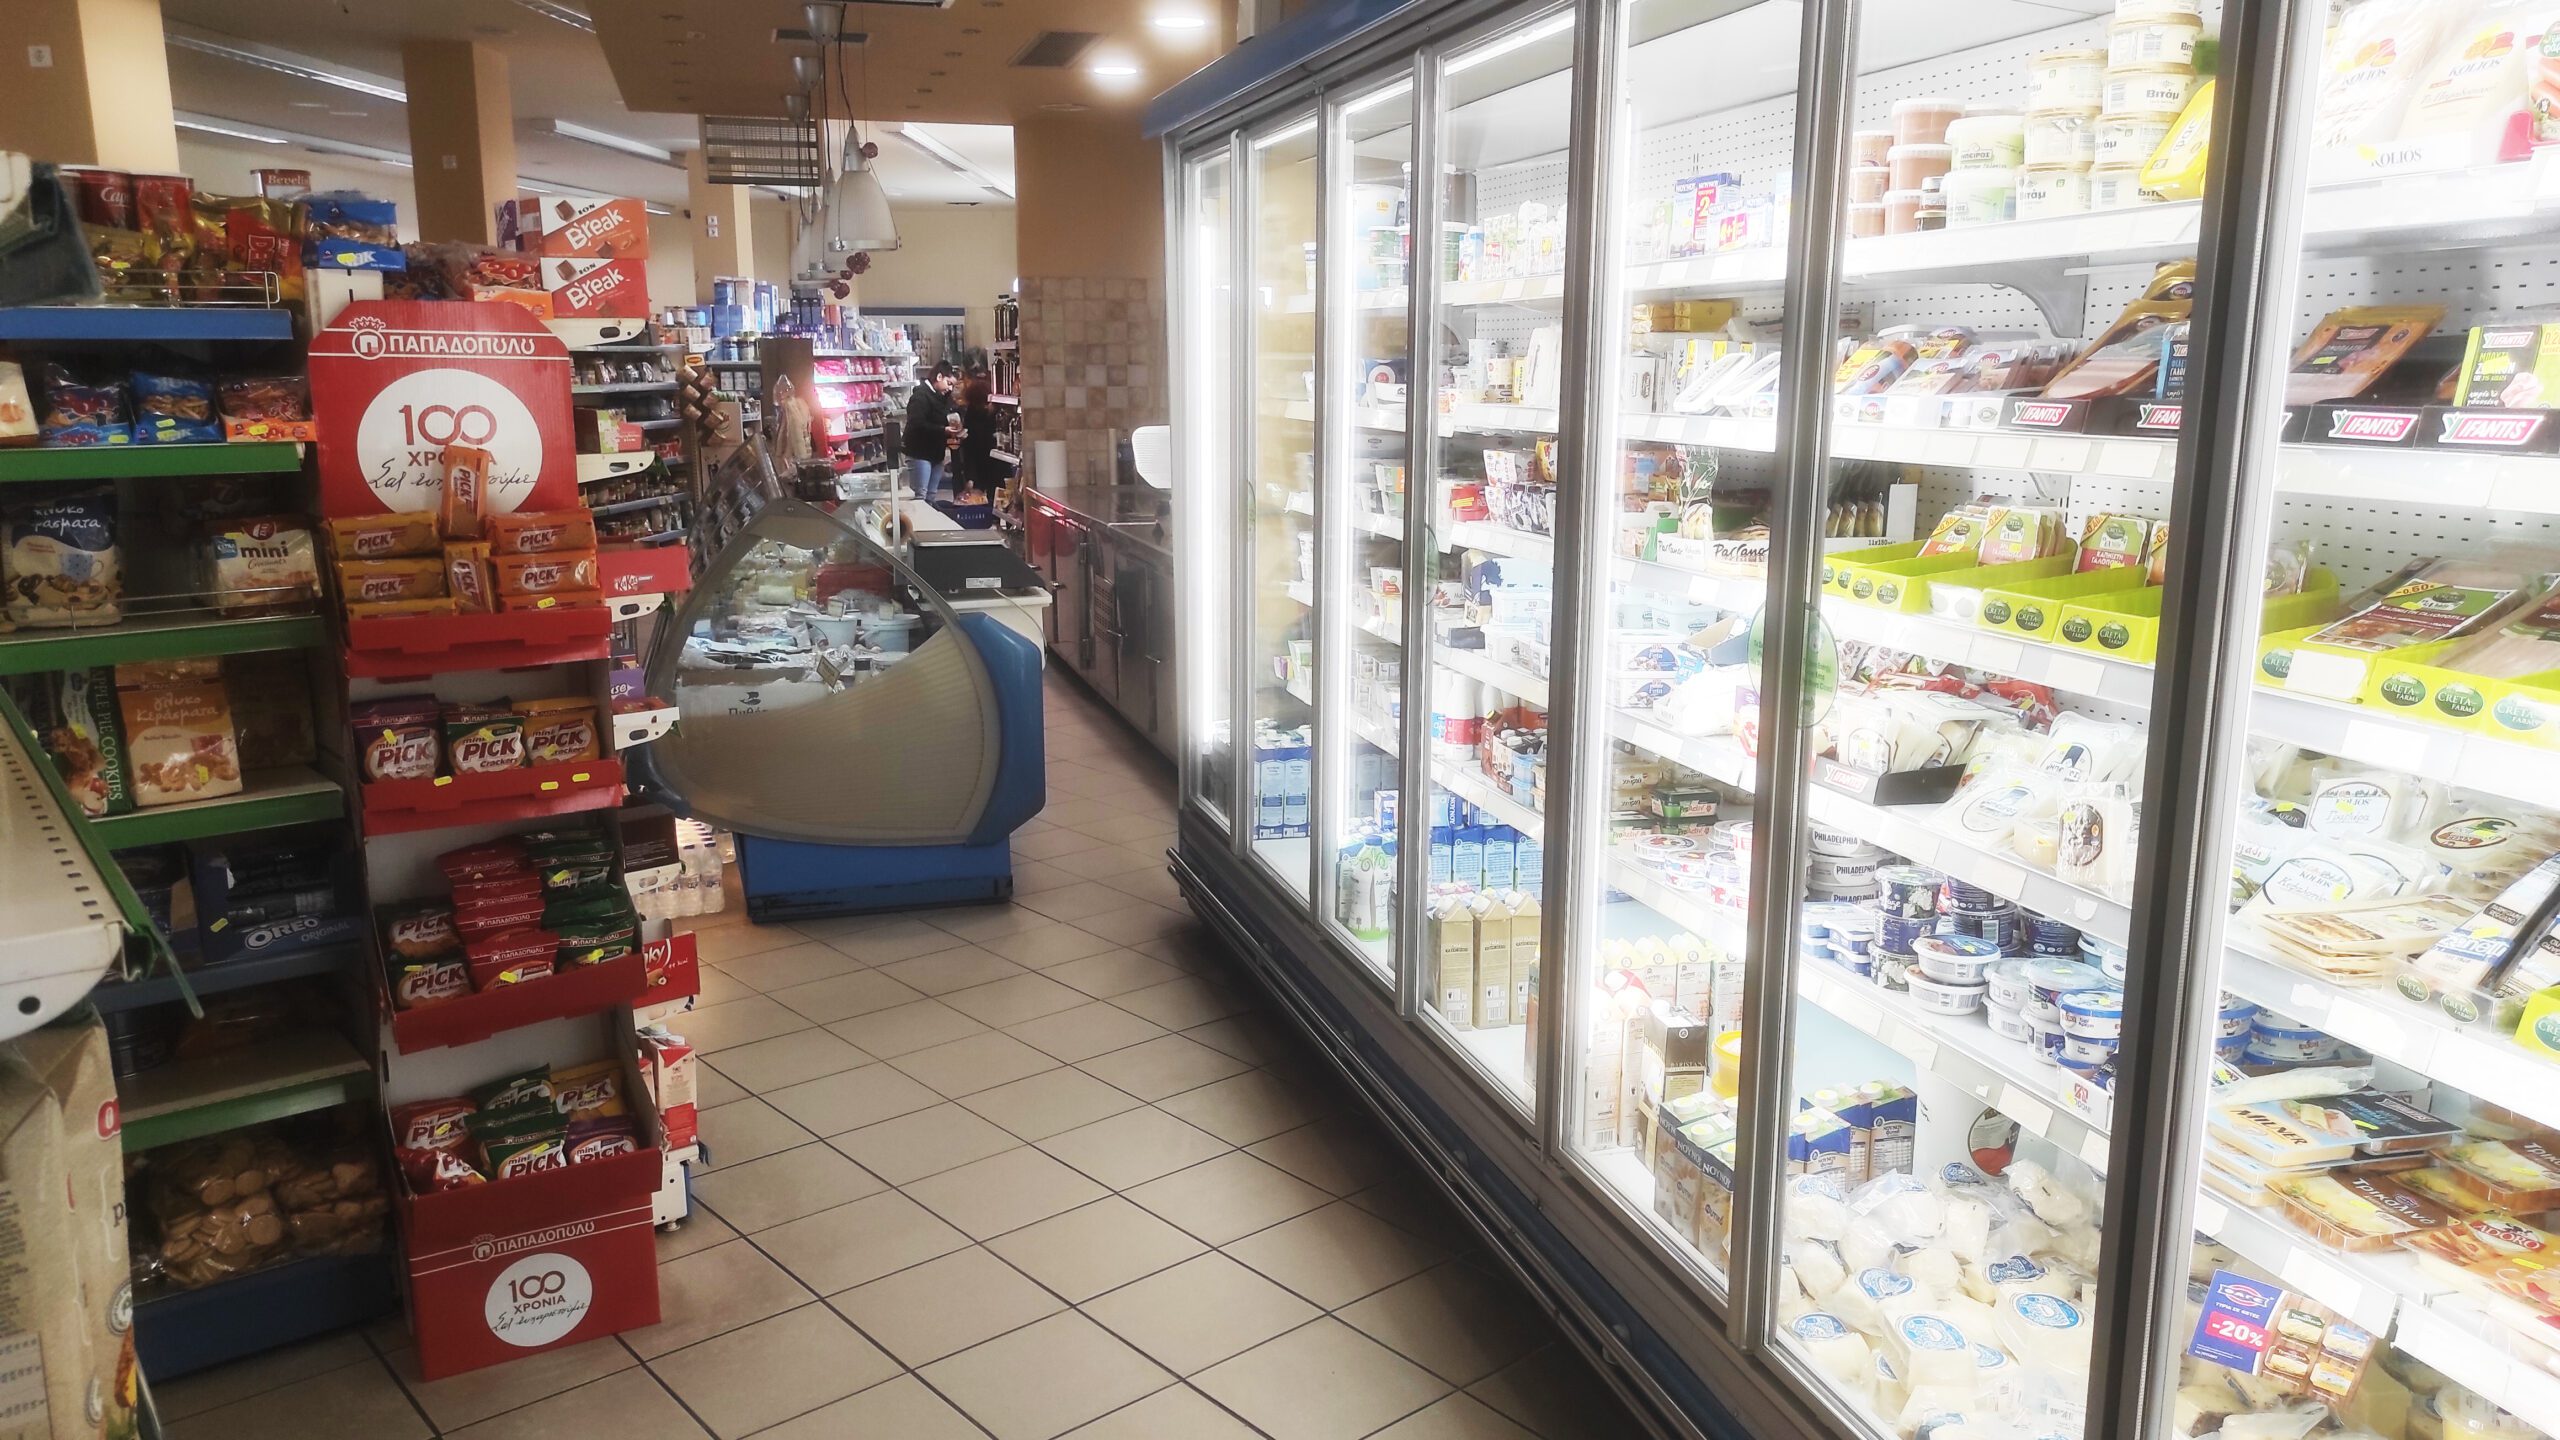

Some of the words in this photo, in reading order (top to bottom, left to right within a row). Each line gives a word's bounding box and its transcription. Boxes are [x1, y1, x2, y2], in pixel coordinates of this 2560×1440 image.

[565, 206, 624, 250] Break
[566, 267, 624, 310] Break
[398, 404, 498, 445] 100
[241, 540, 289, 558] mini
[357, 535, 390, 550] PICK
[520, 533, 551, 547] PICK
[524, 568, 559, 585] PICK
[364, 580, 398, 596] PICK
[2382, 682, 2416, 695] CRETA
[2395, 692, 2419, 703] FARMS
[2437, 691, 2472, 706] CRETA
[2451, 702, 2476, 714] FARMS
[2496, 703, 2537, 719] CRETA
[532, 727, 584, 747] PICK
[377, 741, 433, 767] PICK
[462, 737, 517, 761] PICK
[100, 735, 122, 801] COOKIES
[480, 757, 518, 768] Crackers
[1814, 830, 1858, 846] PHILADELPHIA
[1836, 865, 1876, 877] PHILADELPHIA
[246, 917, 320, 950] OREO
[301, 921, 349, 943] ORIGINAL
[410, 964, 464, 995] PICK
[2231, 1108, 2309, 1147] MILNER
[508, 1150, 563, 1178] PICK
[2351, 1176, 2440, 1228] Τρικαλινό
[2472, 1221, 2542, 1252] ADORO
[507, 1270, 566, 1304] 100
[513, 1294, 567, 1315] ΧΡΟΝΙΑ
[2211, 1318, 2264, 1348] -20%
